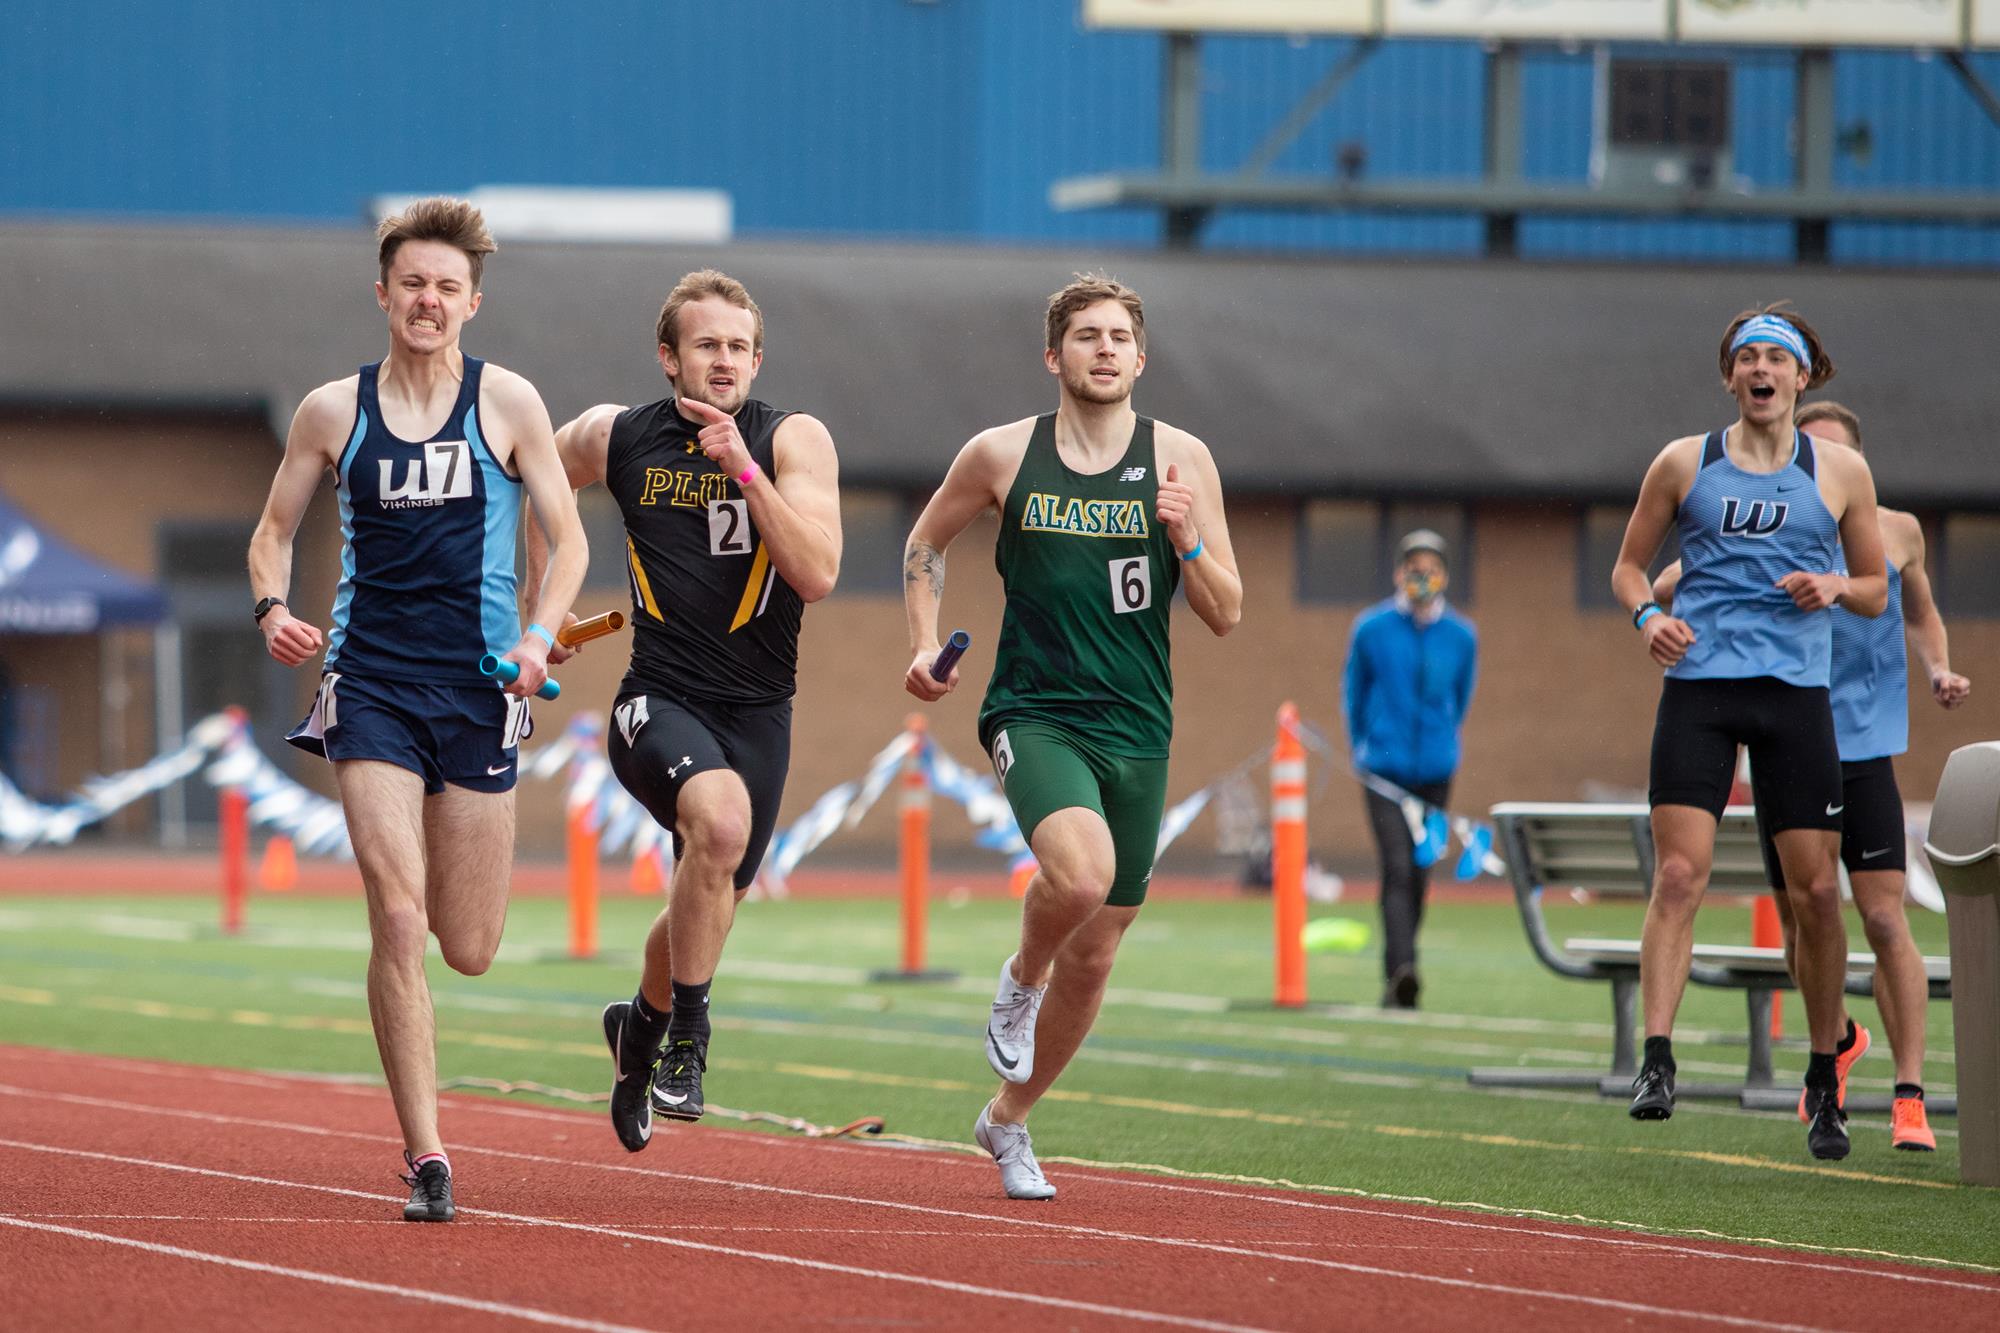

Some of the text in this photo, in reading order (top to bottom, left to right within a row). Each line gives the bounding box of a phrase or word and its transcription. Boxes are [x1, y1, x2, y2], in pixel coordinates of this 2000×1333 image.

[435, 445, 459, 494] 7
[640, 467, 729, 509] PLU
[380, 498, 445, 510] VIKINGS
[1021, 492, 1149, 538] ALASKA
[717, 503, 743, 551] 2
[1121, 560, 1145, 609] 6
[620, 699, 644, 740] 2
[994, 737, 1008, 777] 6
